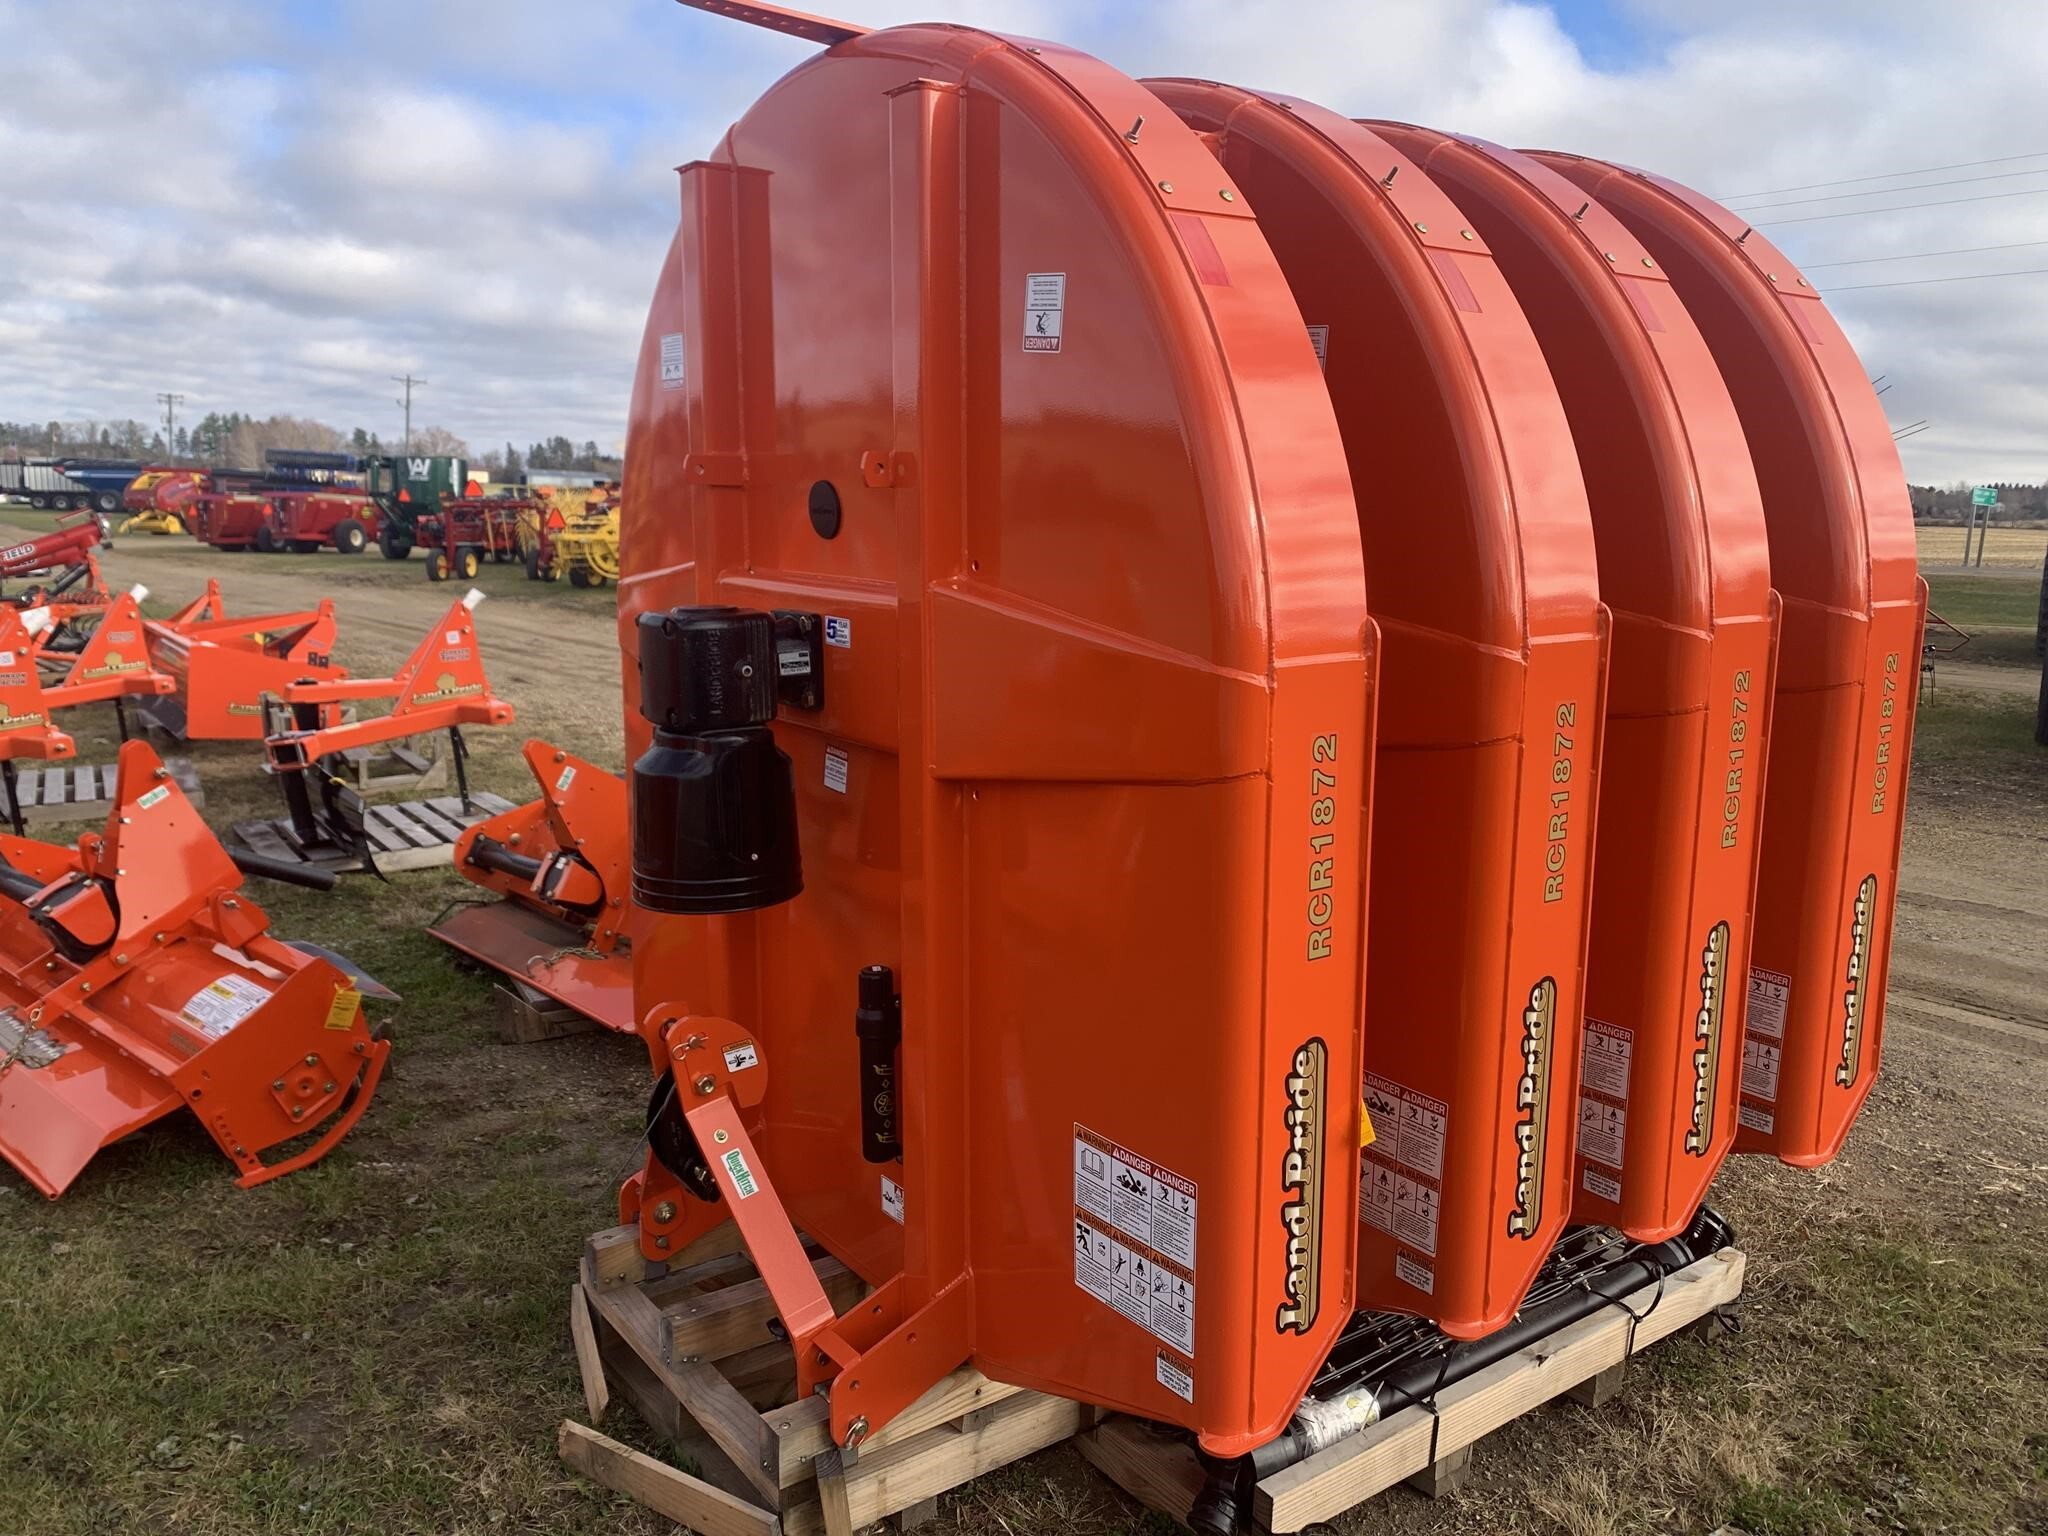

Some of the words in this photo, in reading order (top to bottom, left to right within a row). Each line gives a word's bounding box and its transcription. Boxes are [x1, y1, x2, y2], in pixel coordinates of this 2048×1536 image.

[1025, 337, 1051, 349] DANGER
[826, 619, 838, 639] 5
[1721, 671, 1750, 848] RCR1872
[1872, 653, 1899, 814] RCR1872
[1308, 734, 1336, 961] RCR1872
[1544, 703, 1575, 903] RCR1872
[1697, 930, 1720, 1038] Pride
[1755, 970, 1788, 986] DANGER
[1837, 992, 1856, 1086] Land
[1848, 881, 1868, 981] Pride
[1519, 985, 1547, 1108] Pride
[1597, 1024, 1631, 1041] DANGER
[1284, 1048, 1316, 1189] Pride
[1368, 1076, 1400, 1097] DANGER
[1411, 1094, 1445, 1116] DANGER
[1591, 1092, 1625, 1109] WARNING
[1687, 1051, 1711, 1152] Land
[1083, 1131, 1111, 1153] WARNING
[1120, 1150, 1152, 1174] DANGER
[1161, 1172, 1195, 1196] DANGER
[1405, 1168, 1439, 1190] WARNING
[1510, 1121, 1539, 1237] Land
[1083, 1210, 1110, 1236] WARNING
[1120, 1232, 1150, 1260] WARNING
[1160, 1257, 1192, 1281] WARNING
[1277, 1203, 1311, 1333] Land
